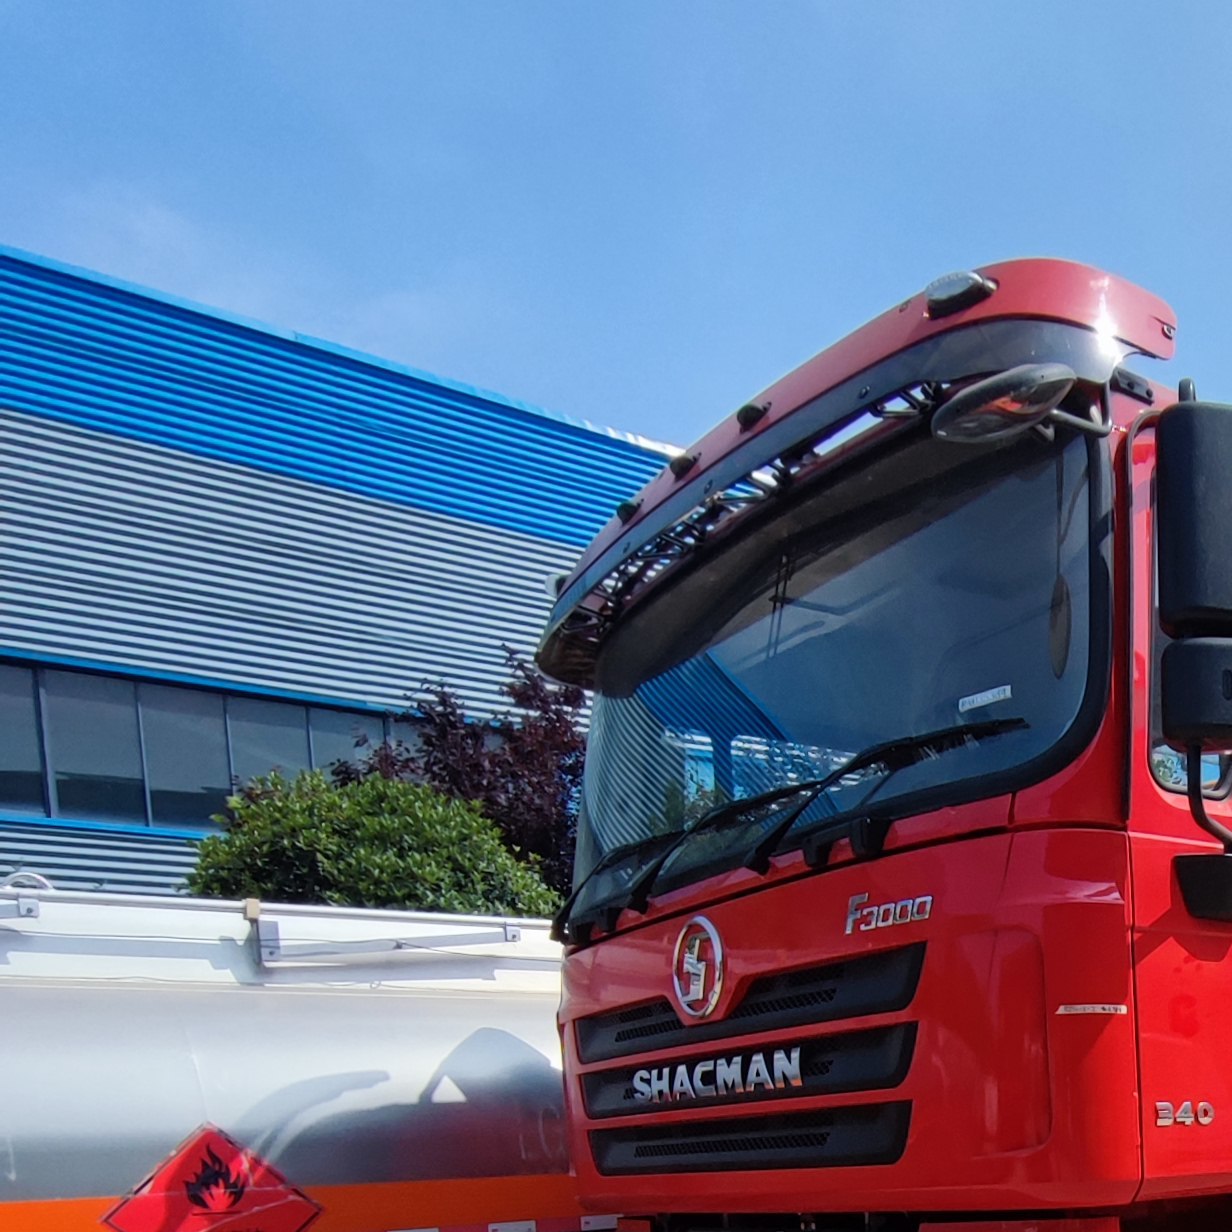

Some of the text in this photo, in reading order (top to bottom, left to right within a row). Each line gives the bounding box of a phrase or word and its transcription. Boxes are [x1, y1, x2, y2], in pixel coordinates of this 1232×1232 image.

[845, 892, 933, 935] F3000
[632, 1047, 803, 1104] SHACMAN
[1155, 1101, 1215, 1127] 340
